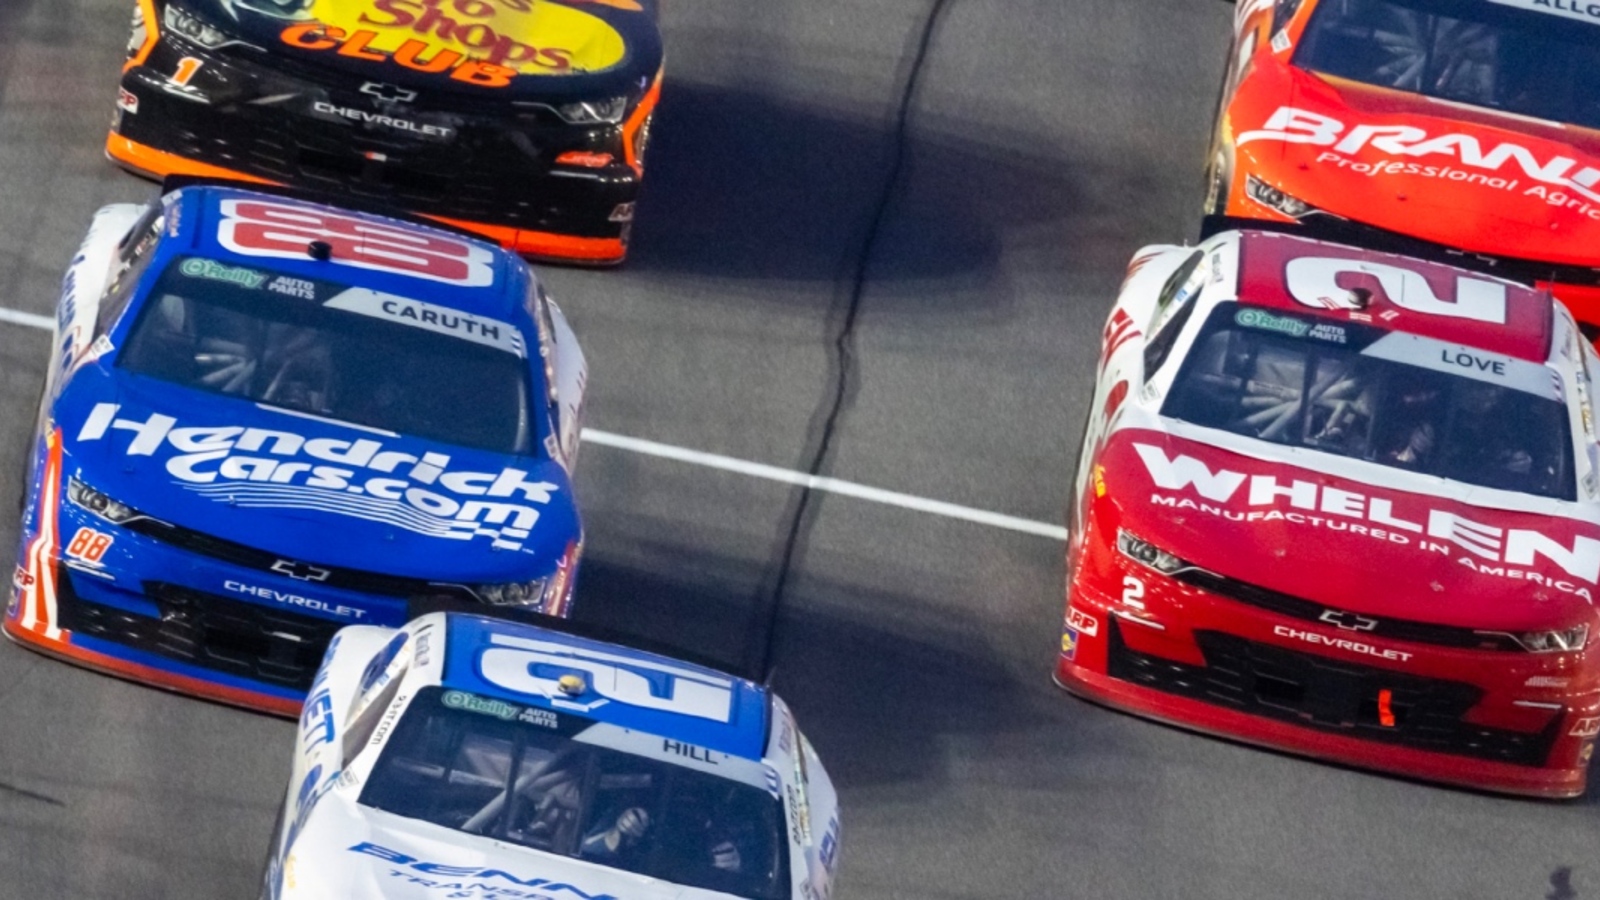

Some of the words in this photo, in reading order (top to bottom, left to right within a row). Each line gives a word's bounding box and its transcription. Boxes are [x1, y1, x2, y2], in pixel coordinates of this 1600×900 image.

[357, 0, 574, 70] Shops
[167, 56, 204, 87] 1
[280, 23, 518, 87] CLUB
[313, 101, 452, 137] CHEVROLET
[1316, 151, 1519, 192] Professional
[268, 282, 316, 301] PARTS
[276, 275, 315, 292] AUTO
[1285, 256, 1507, 324] 2
[381, 300, 500, 341] CARUTH
[1308, 330, 1347, 344] PARTS
[1313, 323, 1346, 336] AUTO
[1441, 349, 1507, 376] LOVE
[76, 402, 559, 504] Hendrick
[165, 449, 540, 530] Cars.com
[1131, 441, 1600, 585] WHELEN
[65, 527, 114, 563] 88
[1150, 493, 1410, 544] MANUFACTURED
[1419, 541, 1450, 556] IN
[1457, 556, 1593, 606] AMERICA
[223, 579, 367, 619] CHEVROLET
[1122, 575, 1146, 610] 2
[1273, 624, 1413, 663] CHEVROLET
[518, 713, 558, 729] PARTS
[524, 707, 557, 721] AUTO
[662, 739, 719, 766] HILL
